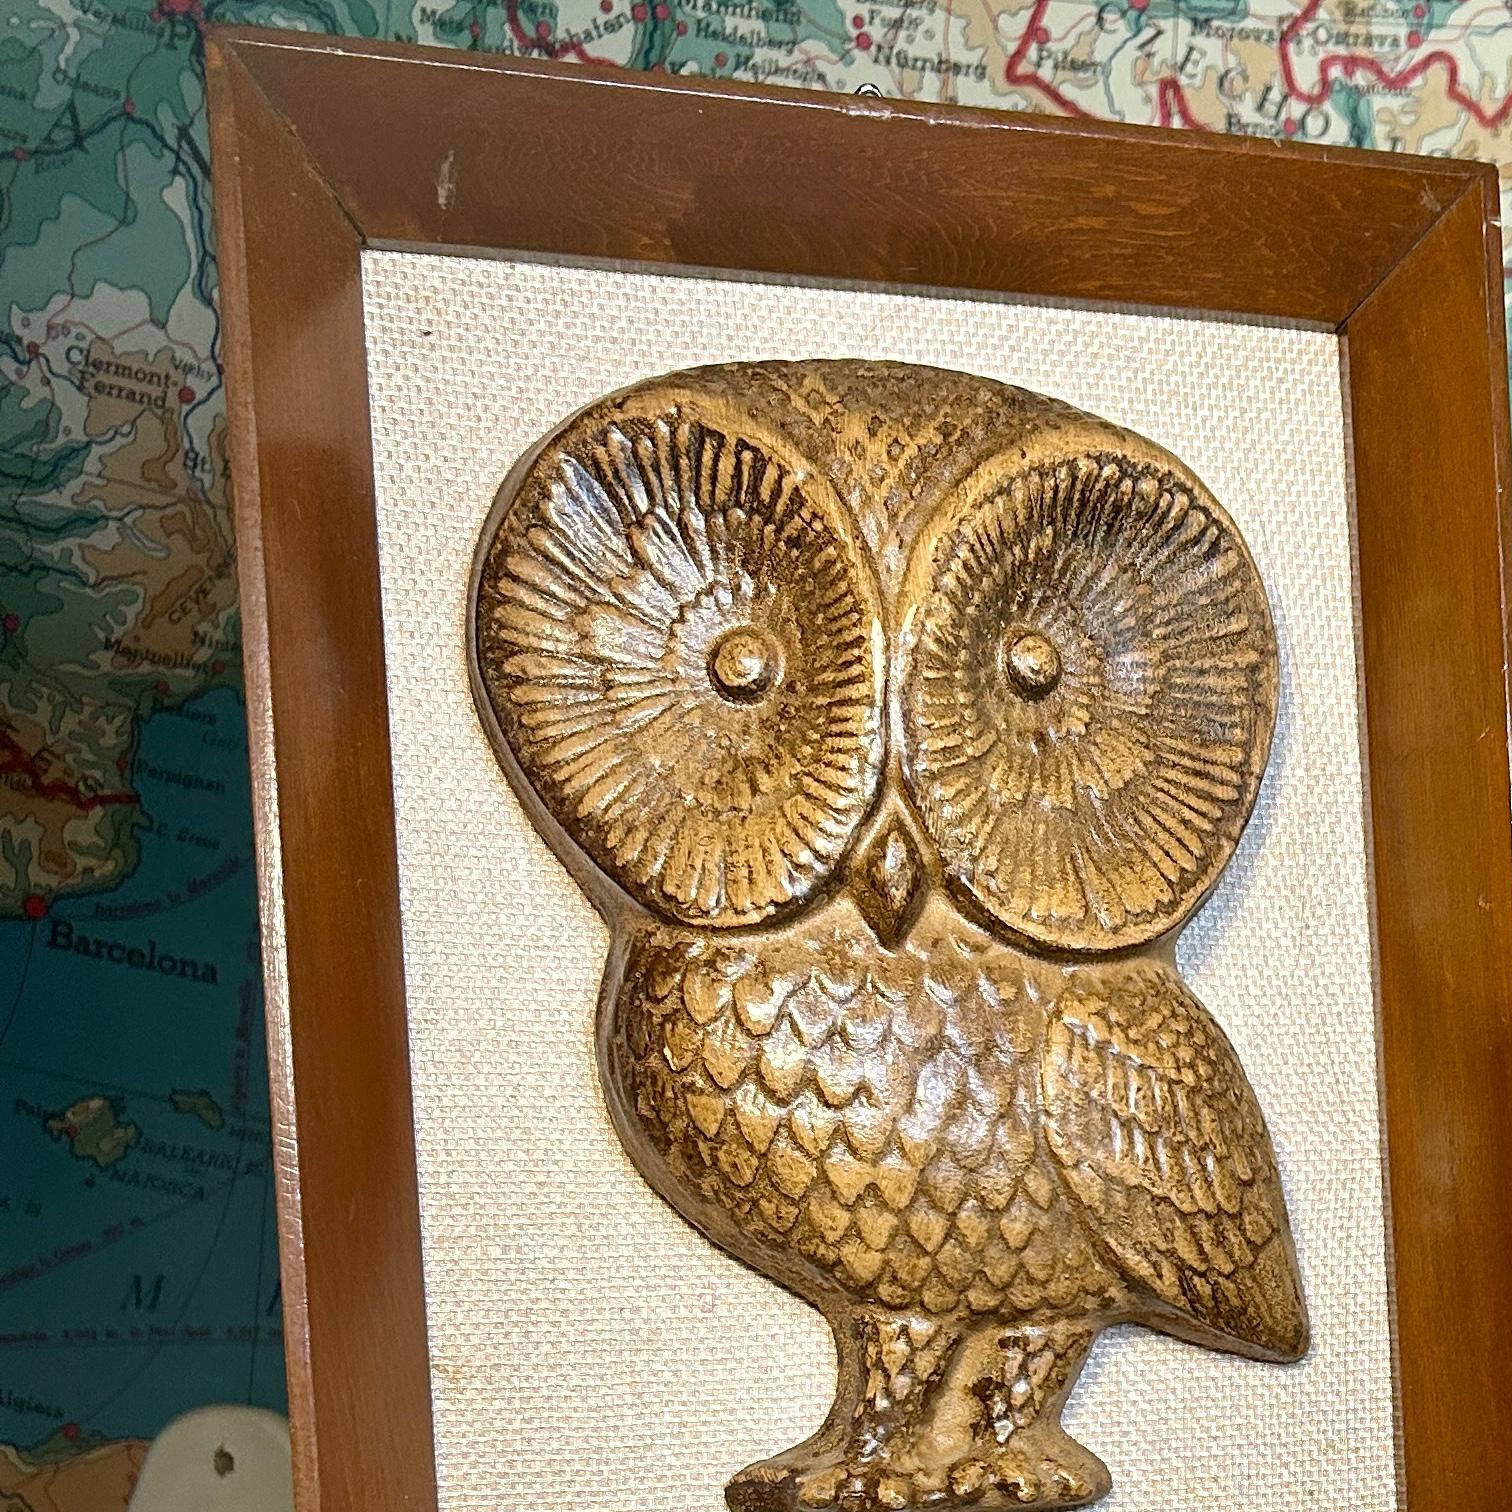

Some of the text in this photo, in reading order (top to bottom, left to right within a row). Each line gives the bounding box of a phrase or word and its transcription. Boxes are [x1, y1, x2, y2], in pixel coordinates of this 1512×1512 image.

[65, 344, 179, 389] Clermont-
[77, 369, 168, 410] Ferrand
[48, 918, 219, 985] Barcelona
